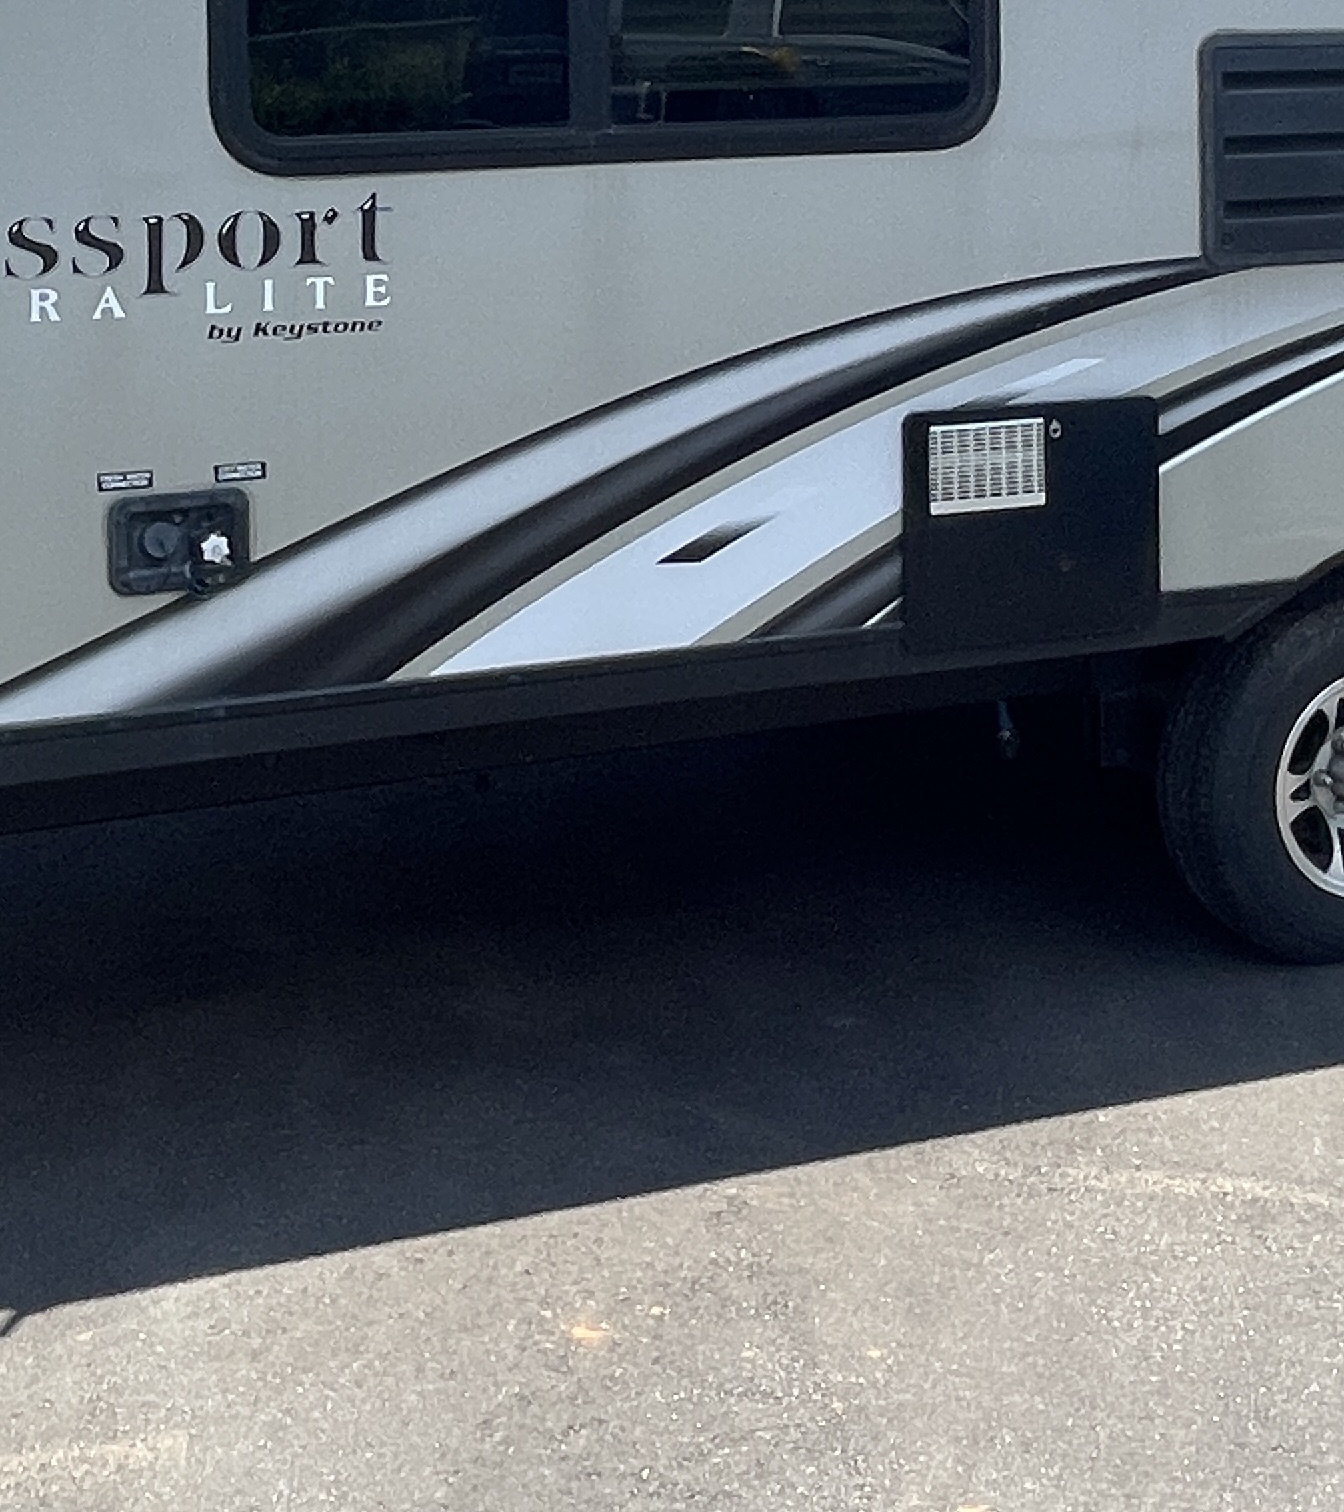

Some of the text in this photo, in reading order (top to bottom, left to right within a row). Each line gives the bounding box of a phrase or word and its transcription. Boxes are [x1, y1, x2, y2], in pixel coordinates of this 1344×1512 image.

[205, 273, 391, 314] LITE
[207, 318, 384, 344] by Keystone
